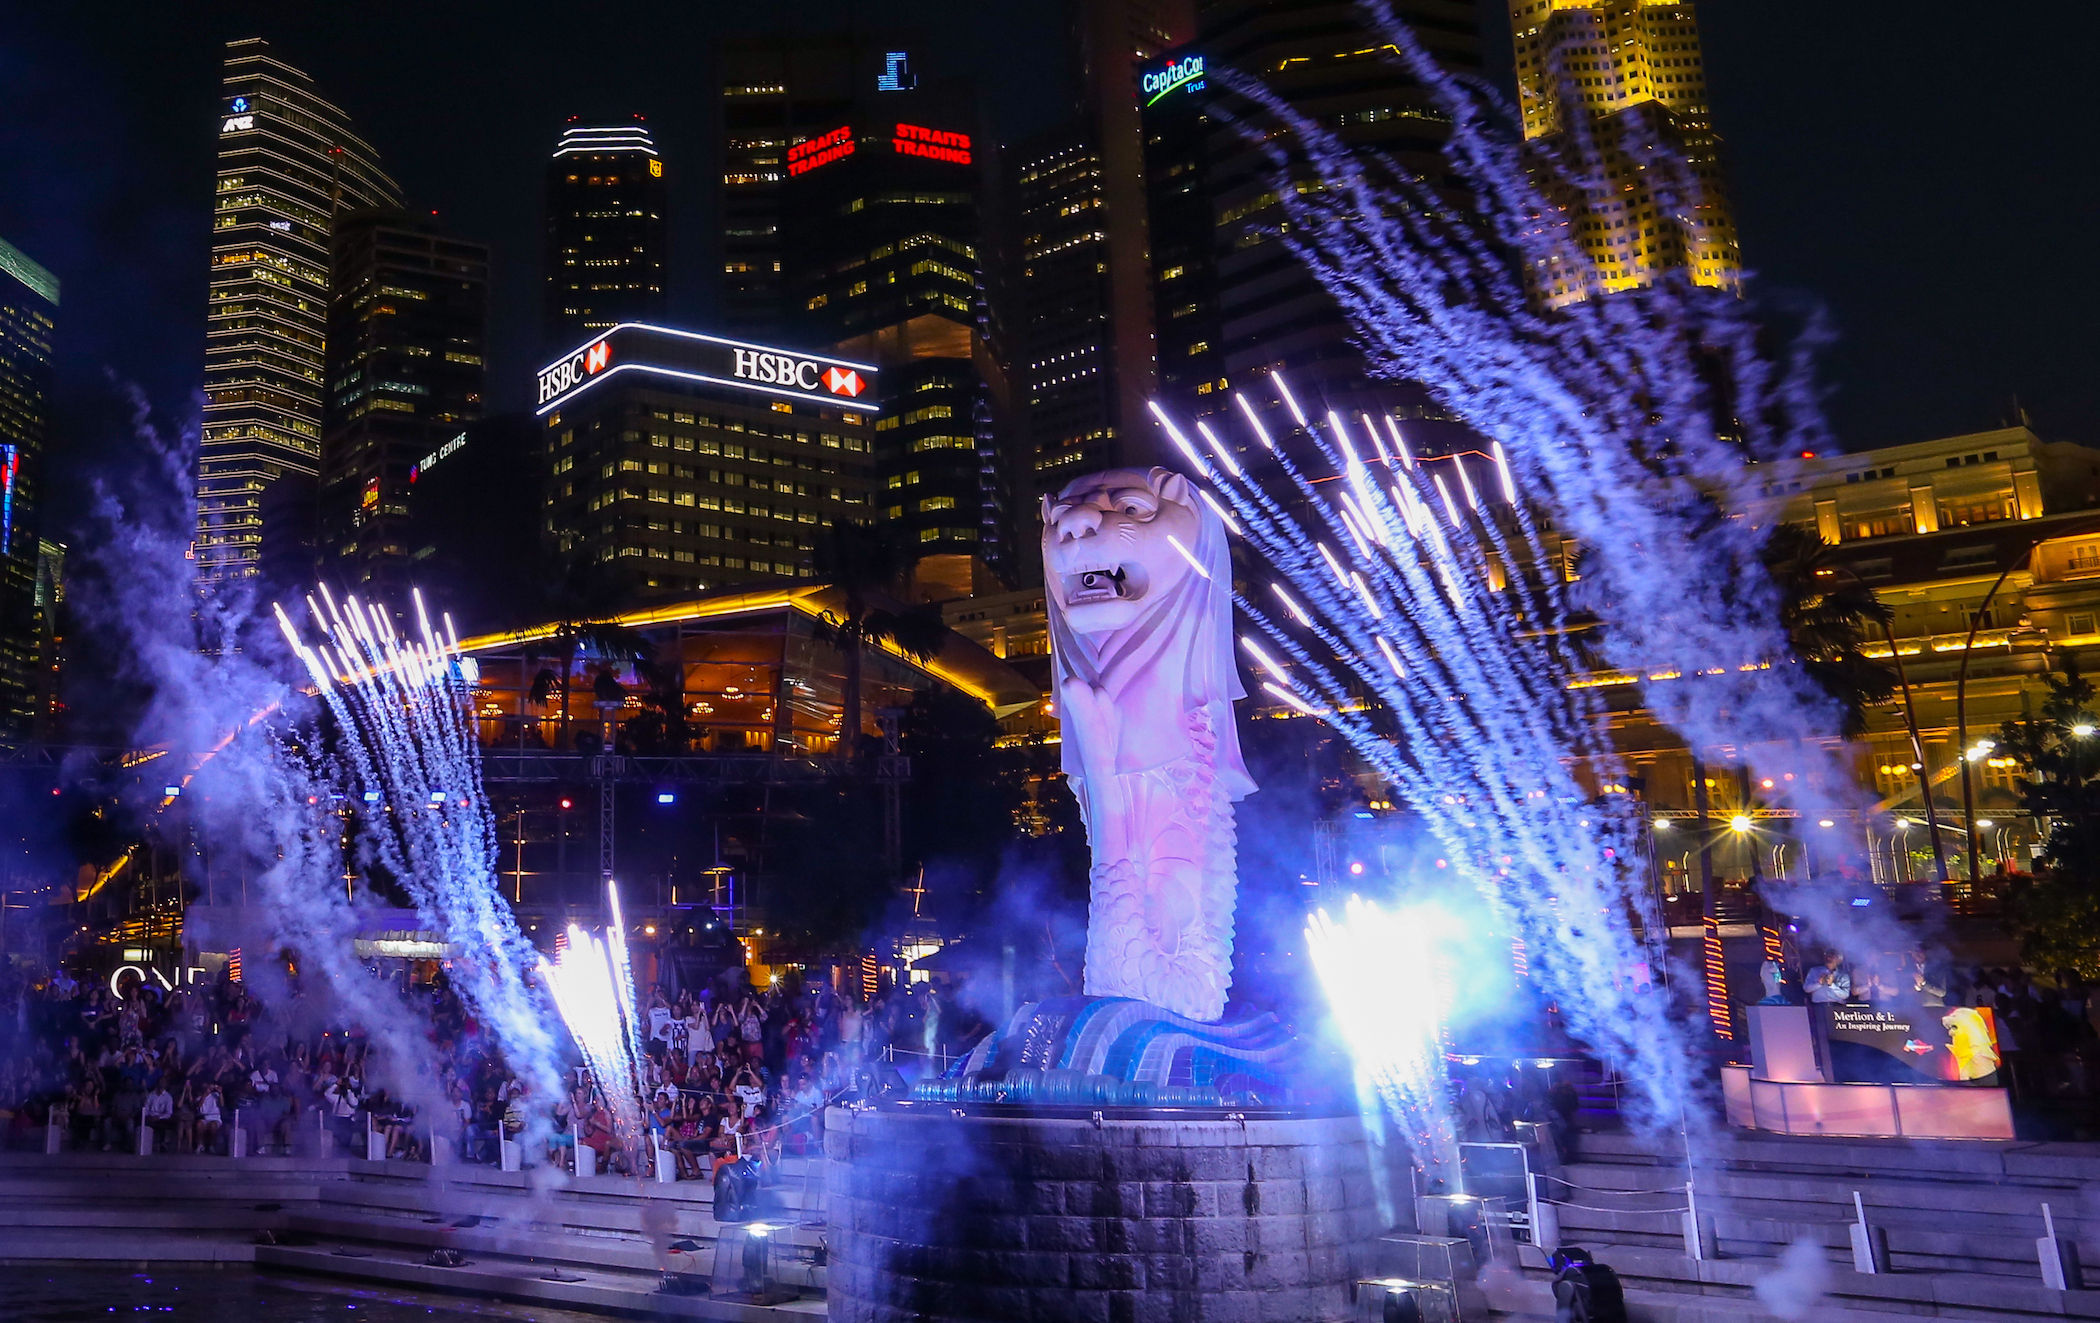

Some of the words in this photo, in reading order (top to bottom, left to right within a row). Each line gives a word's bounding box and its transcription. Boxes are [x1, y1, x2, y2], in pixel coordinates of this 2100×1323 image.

[788, 126, 851, 162] STRAITS
[892, 138, 971, 165] TRADING
[896, 123, 971, 148] STRAITS
[788, 140, 855, 177] TRADING
[537, 353, 584, 405] HSBC
[733, 348, 818, 390] HSBC
[419, 452, 437, 473] TUNG
[439, 431, 467, 460] CENTRE
[1833, 1011, 1874, 1021] Merlion
[1876, 1011, 1885, 1021] &
[1848, 1023, 1881, 1032] Inspiring
[1882, 1023, 1910, 1032] Journey
